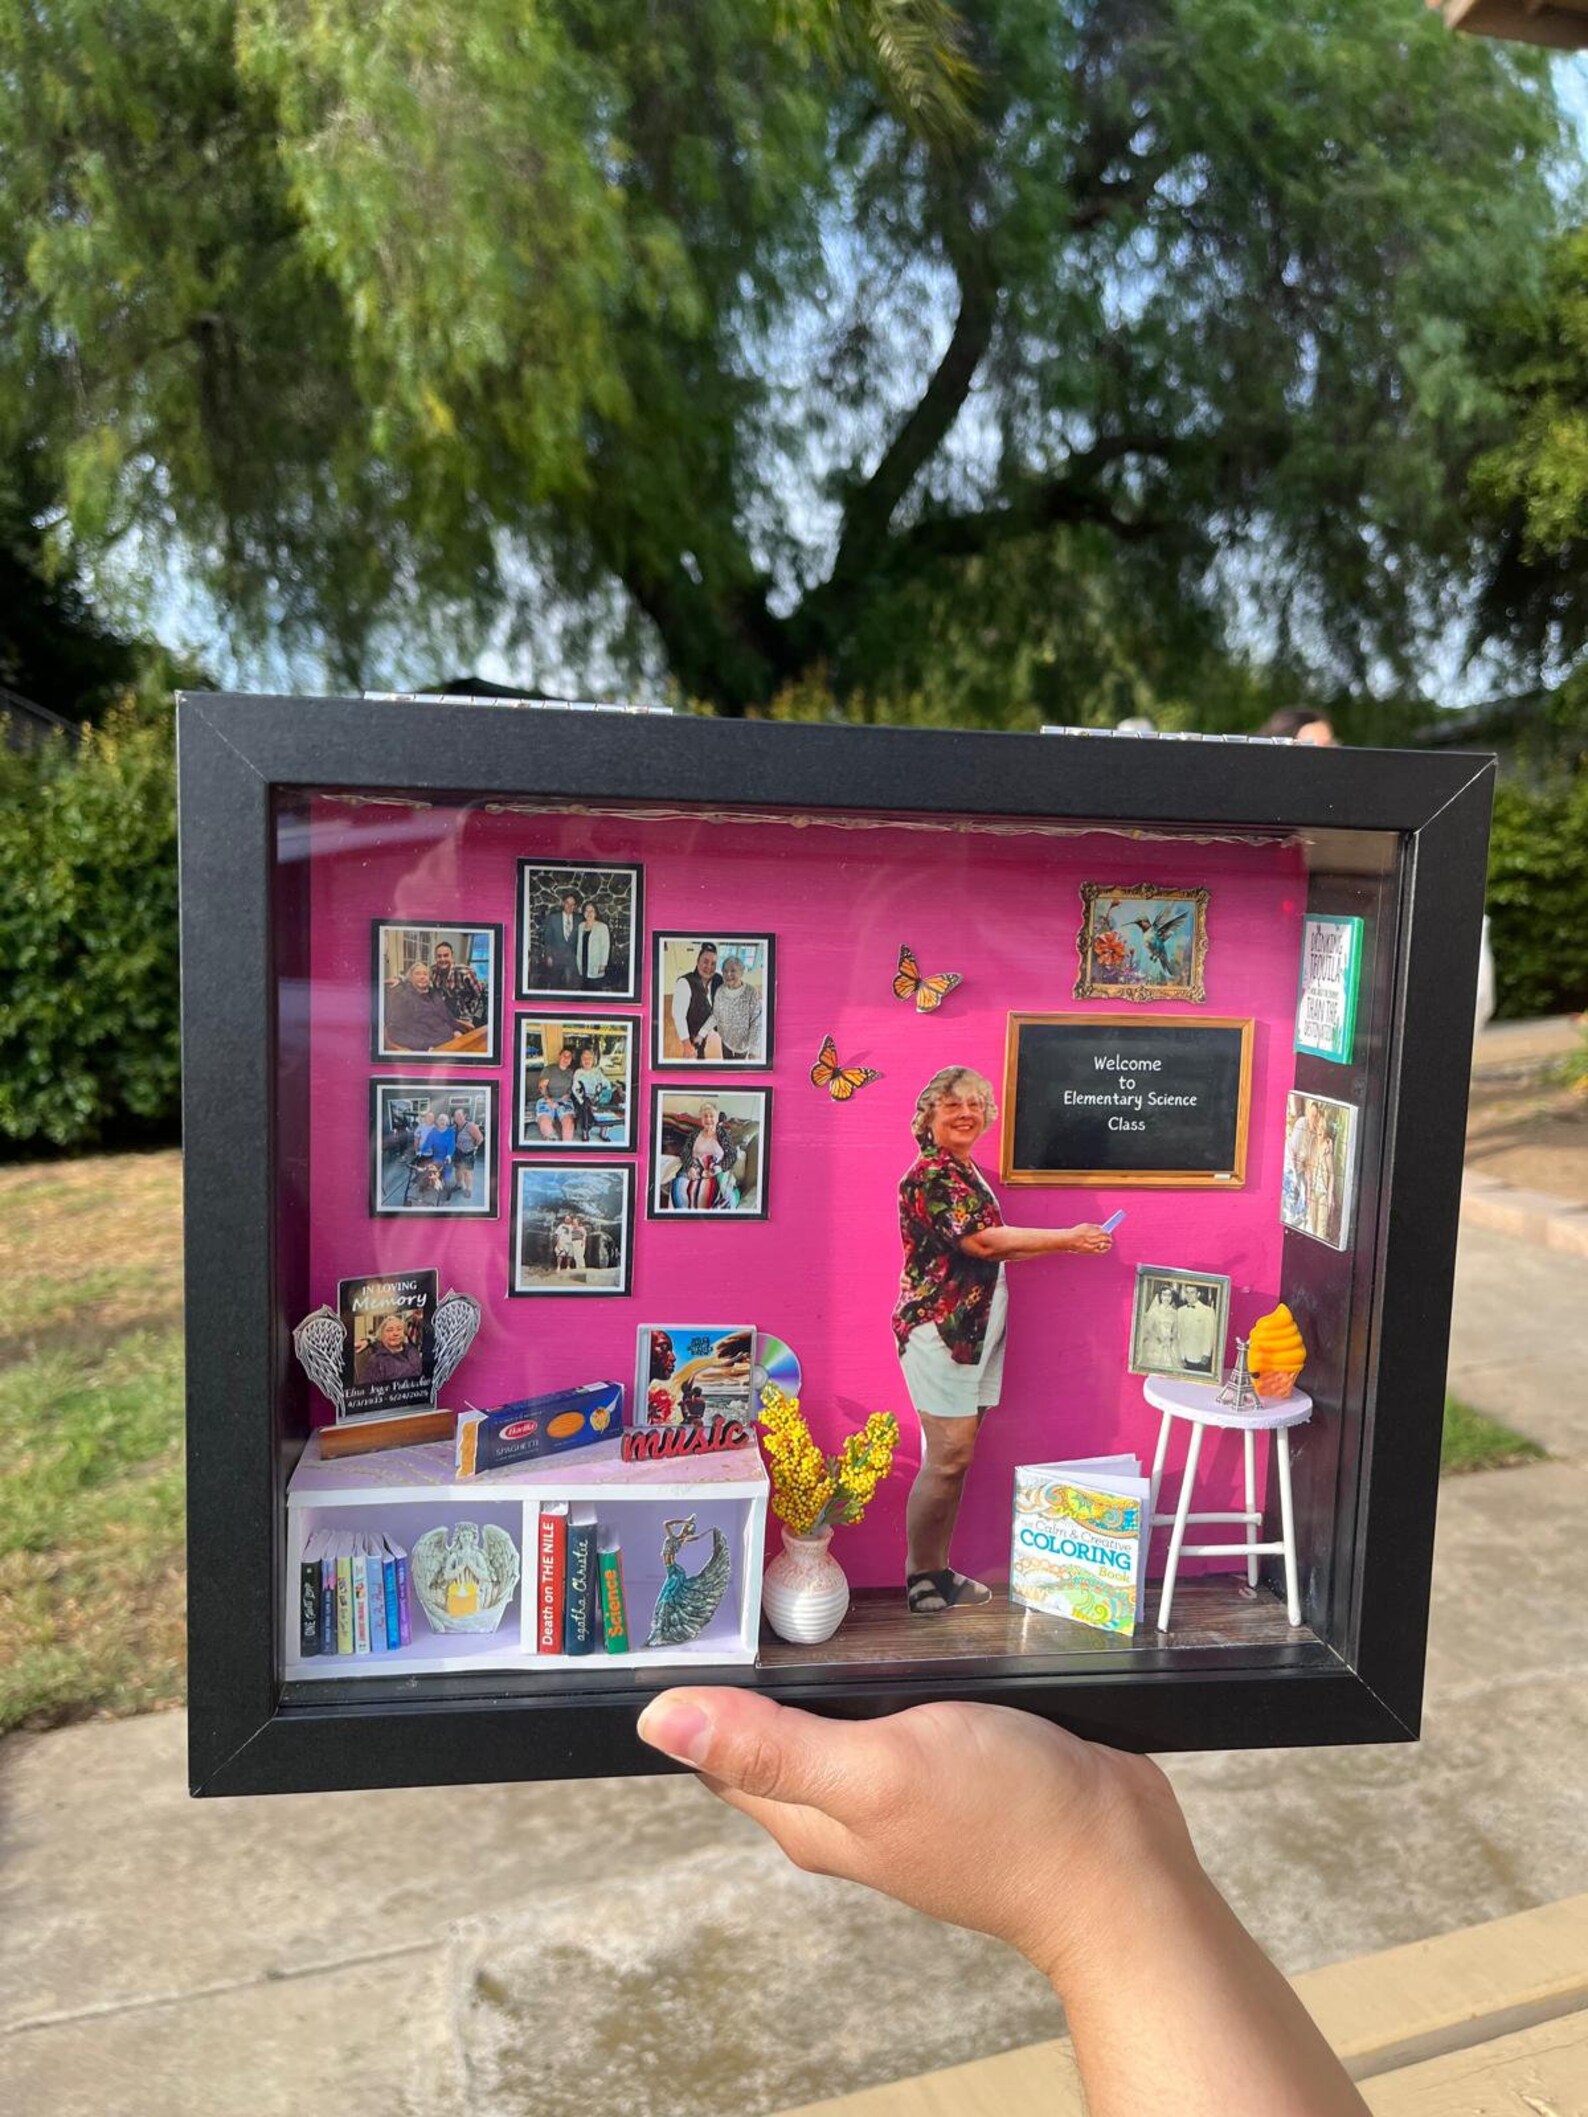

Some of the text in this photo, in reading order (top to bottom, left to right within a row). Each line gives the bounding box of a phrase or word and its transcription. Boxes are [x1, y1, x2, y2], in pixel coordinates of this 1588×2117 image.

[1310, 953, 1341, 985] TEQUILA
[1306, 997, 1338, 1025] THAN THE
[1094, 1054, 1162, 1071] Welcome
[1119, 1076, 1136, 1089] to
[1064, 1091, 1197, 1110] Elementary Science
[1108, 1117, 1145, 1131] Class
[362, 1280, 417, 1296] IN LOVING
[352, 1293, 427, 1312] Memory
[508, 1423, 535, 1436] Barilla
[621, 1414, 749, 1462] music
[496, 1439, 539, 1455] SPAGHETTI
[1036, 1520, 1067, 1536] Calm
[1069, 1529, 1079, 1539] &
[1081, 1531, 1132, 1551] Creative
[1020, 1529, 1131, 1571] COLORING
[571, 1539, 589, 1592] Christie
[1099, 1566, 1130, 1582] Book
[542, 1522, 554, 1646] Death on THE NILE
[604, 1569, 623, 1637] Science
